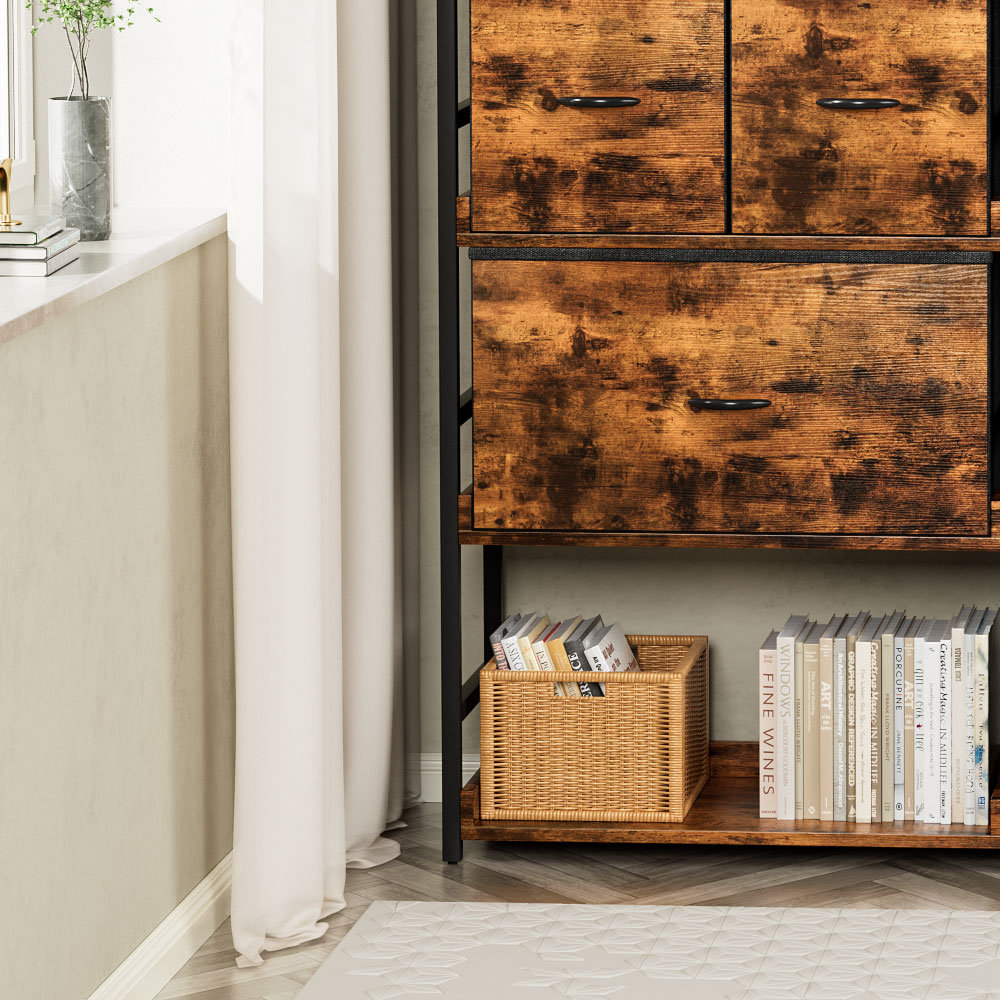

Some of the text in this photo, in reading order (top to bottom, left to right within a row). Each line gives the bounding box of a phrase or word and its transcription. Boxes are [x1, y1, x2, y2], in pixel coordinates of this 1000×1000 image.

[492, 642, 505, 661] INTO
[508, 647, 520, 662] SIX
[837, 653, 843, 663] An
[779, 644, 791, 718] WINDOWS
[762, 673, 774, 718] FINE
[820, 681, 831, 710] ART
[904, 680, 913, 709] ART
[870, 727, 878, 738] IN
[939, 727, 947, 739] IN
[762, 728, 774, 795] WINES
